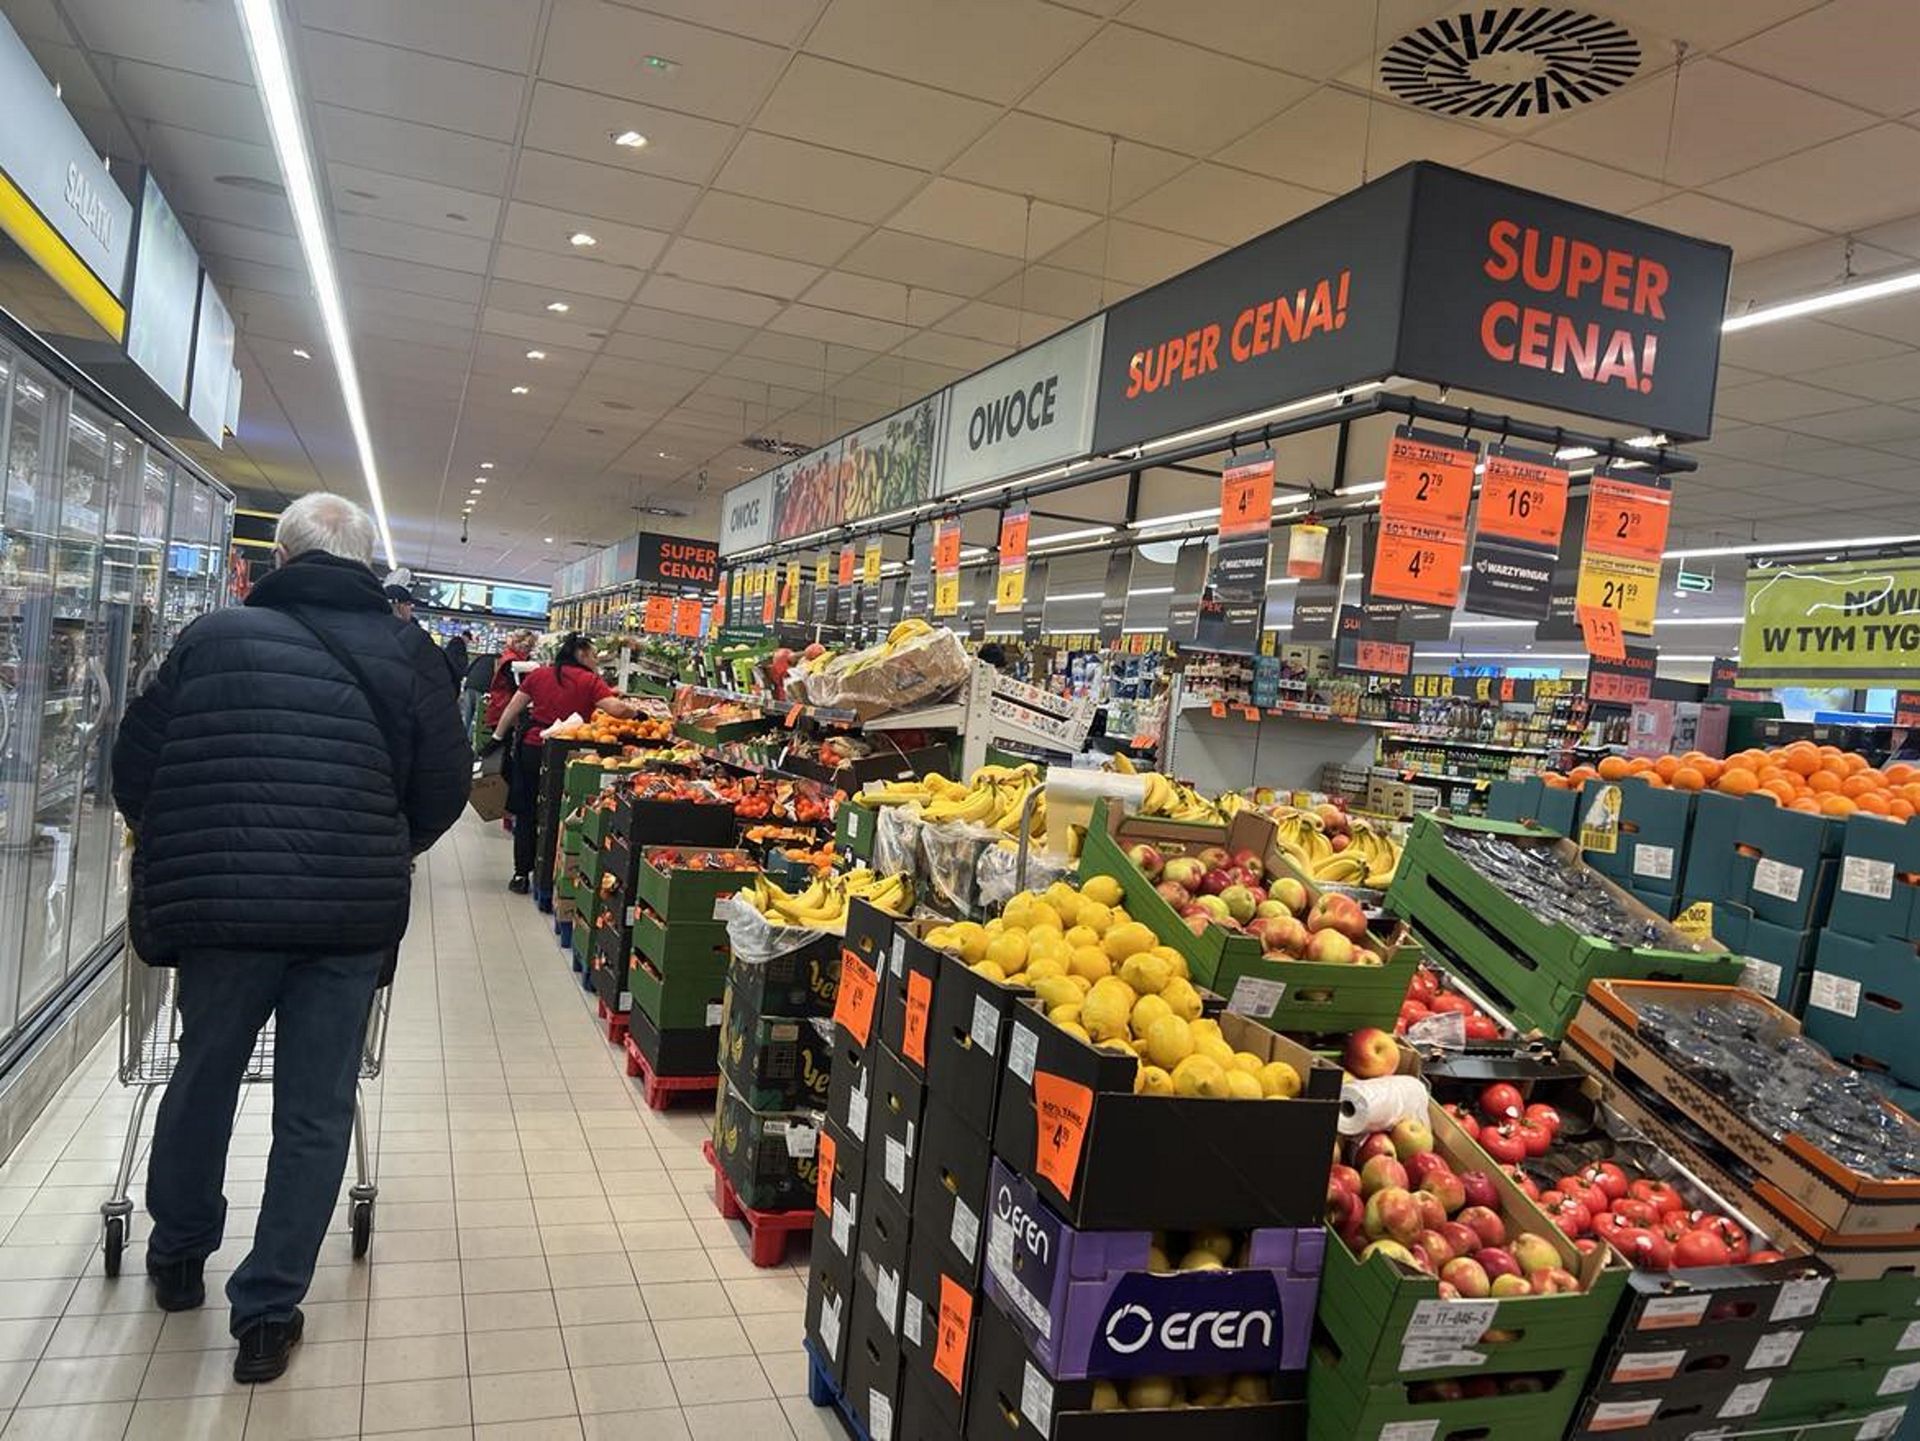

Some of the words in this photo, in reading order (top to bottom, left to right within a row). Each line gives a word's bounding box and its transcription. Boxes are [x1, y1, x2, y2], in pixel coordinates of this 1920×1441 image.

[1484, 219, 1671, 321] SUPER
[1126, 323, 1219, 399] SUPER
[1231, 269, 1351, 363] CENA!
[1481, 301, 1657, 394] CENA!
[968, 375, 1058, 451] OWOCE
[730, 498, 760, 533] OWOCE
[660, 543, 716, 564] SUPER
[659, 561, 714, 582] CENA!
[1487, 562, 1550, 582] WARZYWNIAK
[1763, 627, 1791, 652] W
[1797, 624, 1856, 651] TYM
